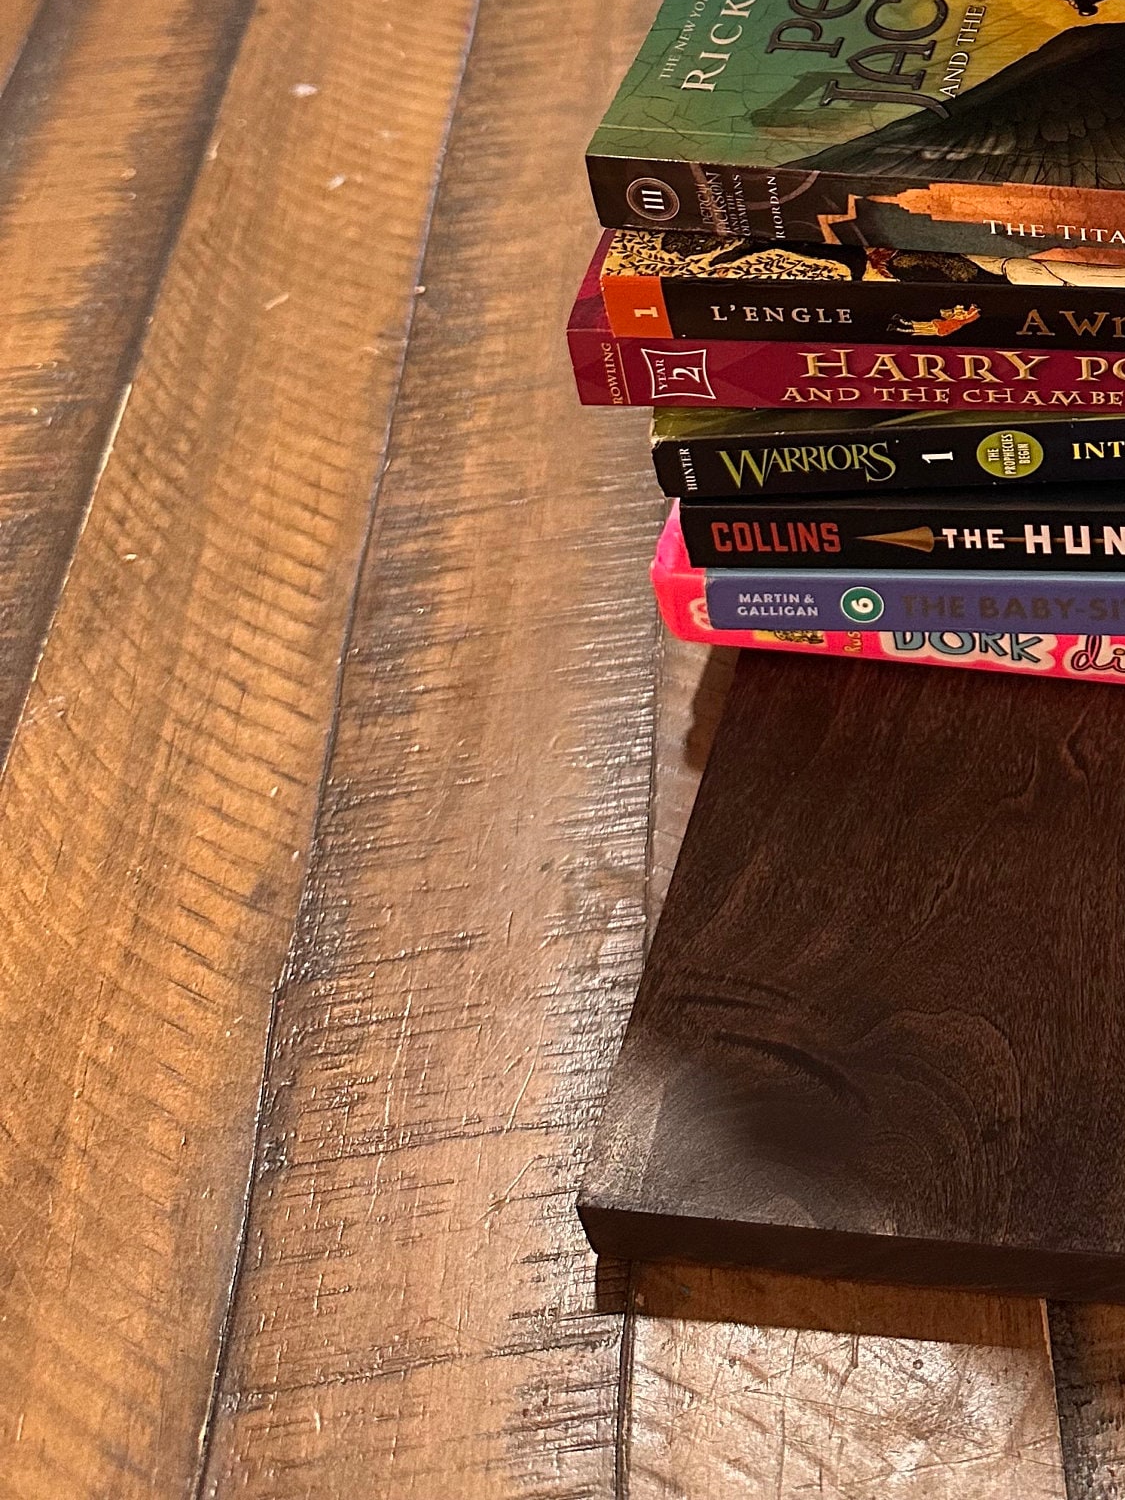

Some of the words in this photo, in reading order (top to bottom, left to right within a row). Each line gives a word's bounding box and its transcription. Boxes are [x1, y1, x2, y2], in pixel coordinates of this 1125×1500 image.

[658, 54, 681, 80] THE
[678, 20, 697, 51] NEW
[939, 49, 971, 99] AND
[956, 5, 986, 47] THE
[641, 190, 665, 210] III
[705, 172, 735, 235] JACKSON
[733, 174, 751, 237] OLYMPIANS
[766, 175, 787, 239] RIORDAN
[982, 219, 1046, 239] THE
[633, 306, 659, 318] 1
[710, 304, 853, 324] L'ENGLE
[1016, 308, 1055, 336] A
[601, 342, 624, 405] ROWLING
[655, 358, 668, 391] YEAR
[668, 366, 704, 384] 2
[797, 348, 1051, 383] HARRY
[781, 386, 861, 403] AND
[873, 386, 950, 404] THE
[716, 442, 897, 488] WARRIORS
[921, 451, 954, 464] 1
[988, 447, 999, 463] THE
[1005, 432, 1017, 476] PROPHECIES
[1019, 442, 1030, 465] BEGIN
[679, 447, 698, 492] HUNTER
[711, 522, 842, 553] COLLINS
[942, 528, 1006, 550] THE
[738, 593, 800, 604] MARTIN
[803, 593, 815, 604] &
[851, 597, 874, 614] 6
[902, 595, 964, 619] THE
[737, 605, 819, 617] GALLIGAN
